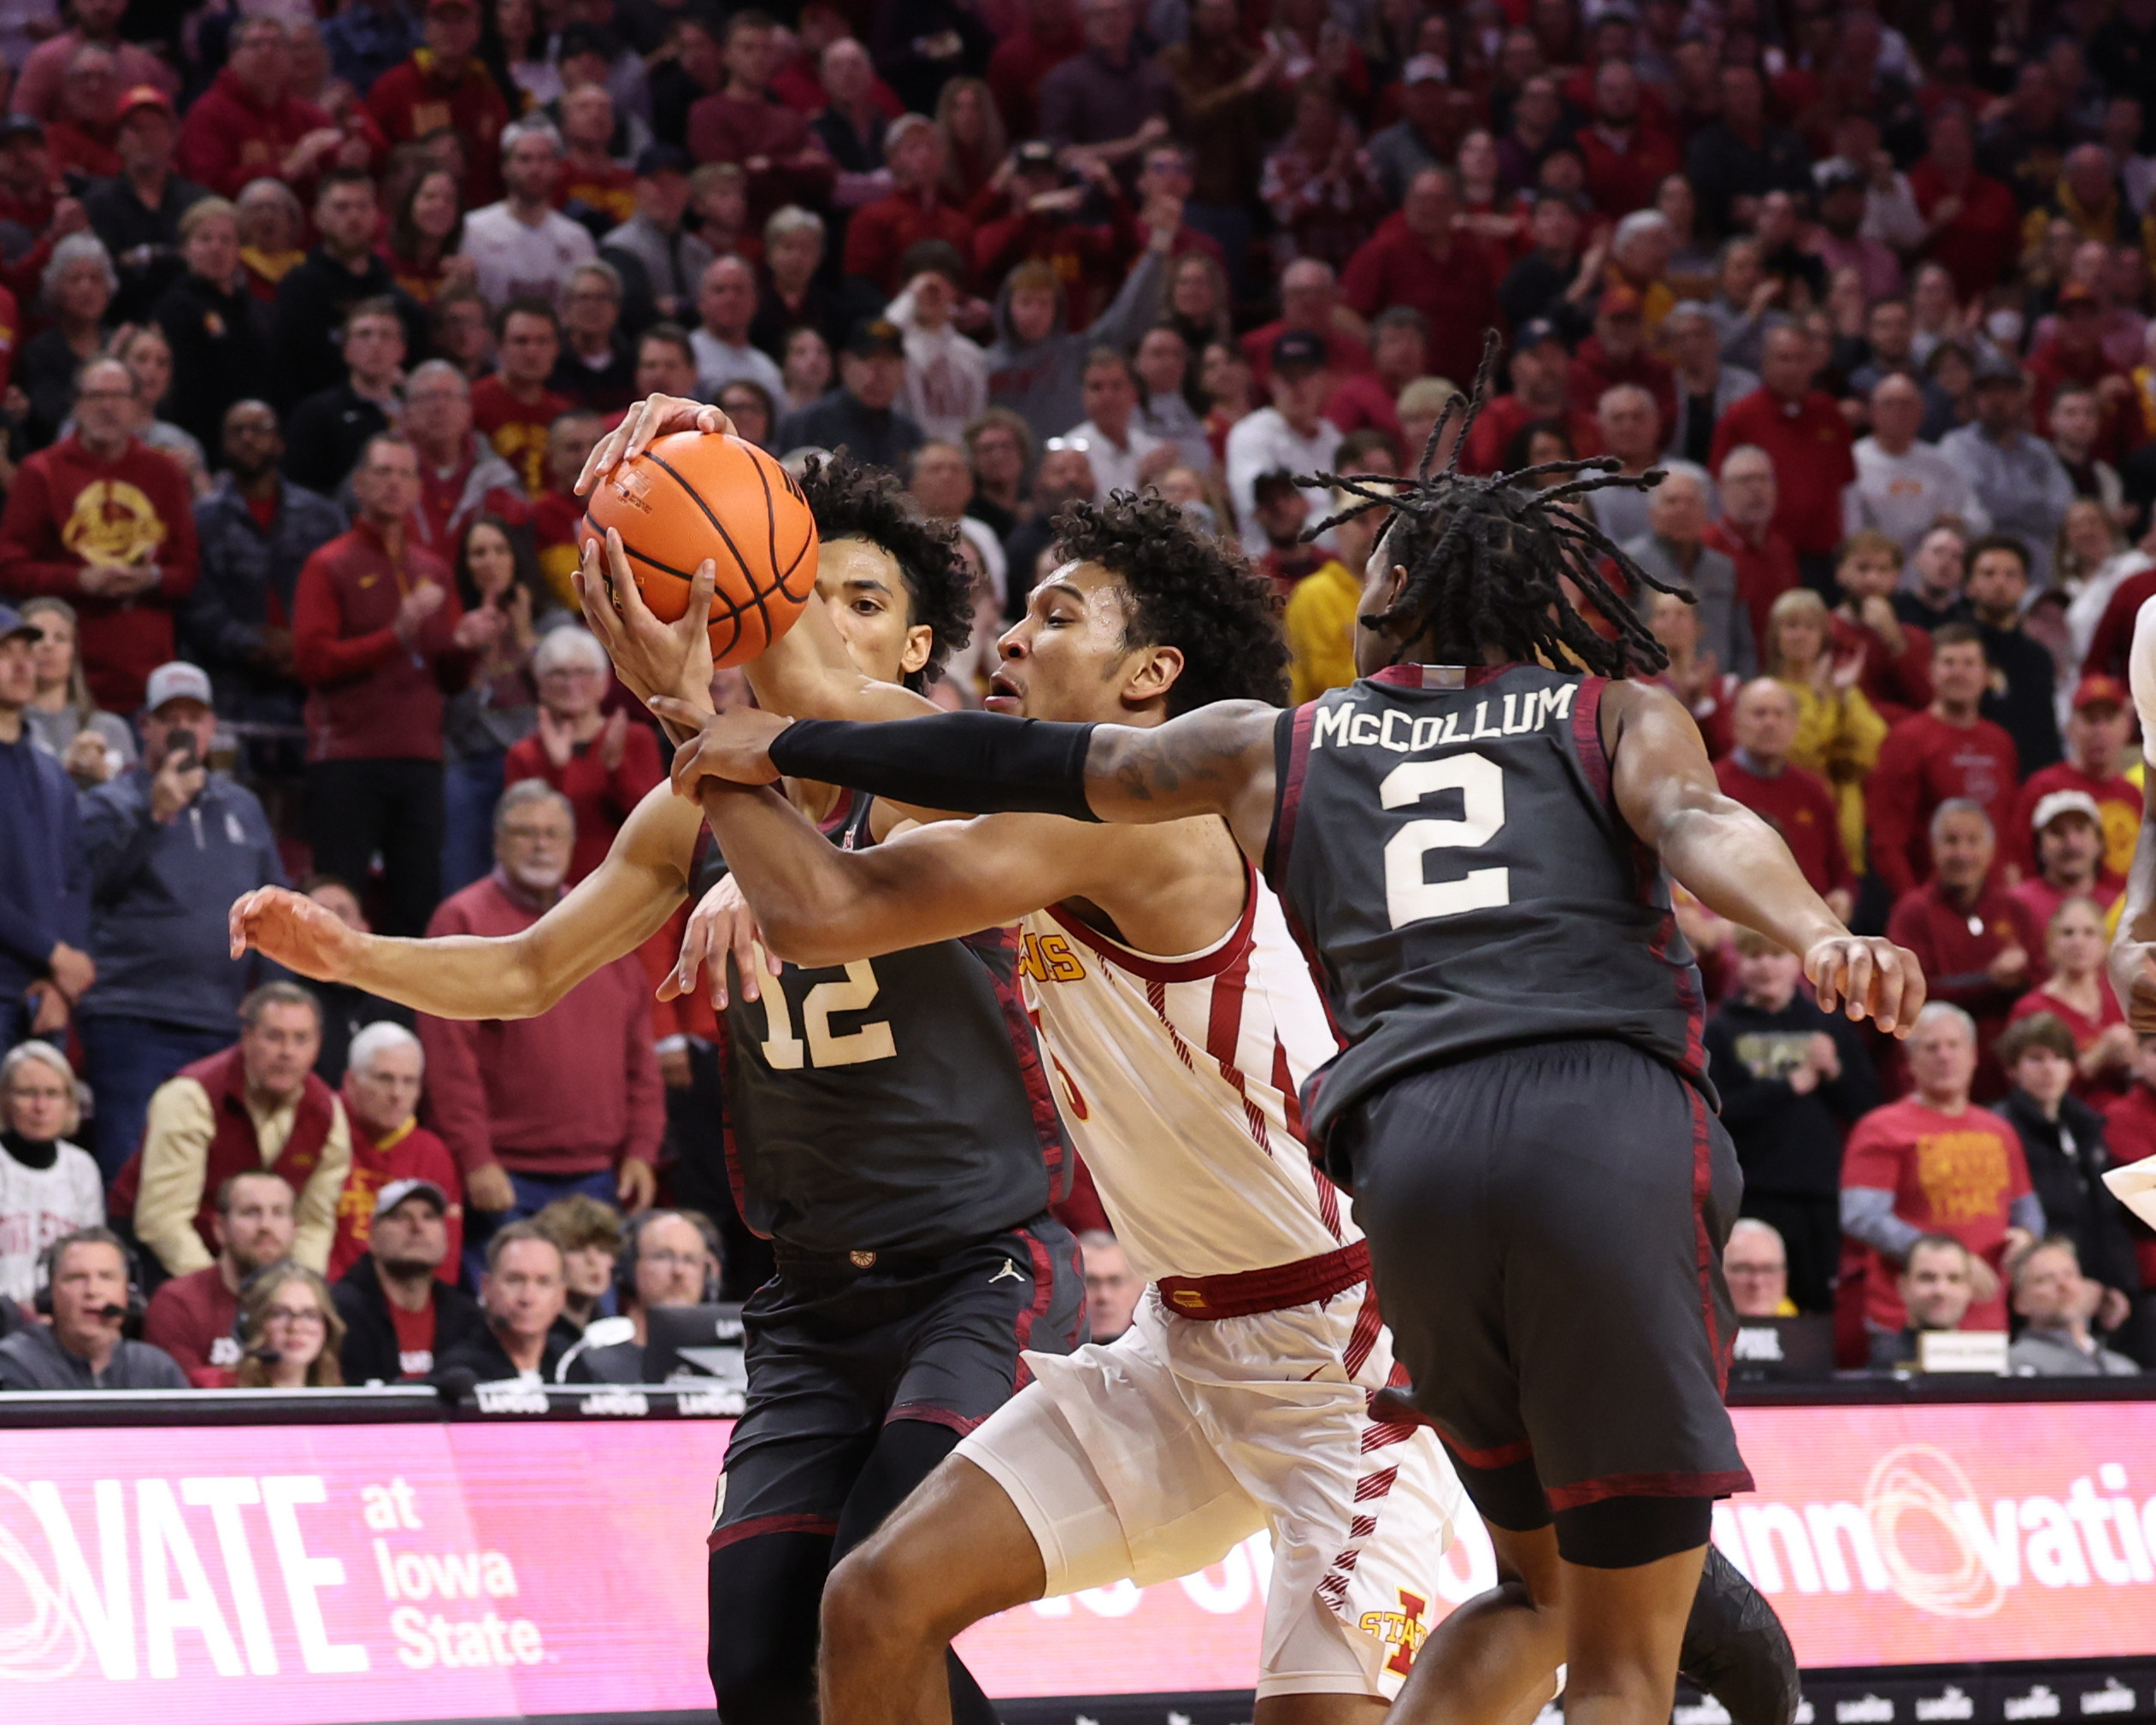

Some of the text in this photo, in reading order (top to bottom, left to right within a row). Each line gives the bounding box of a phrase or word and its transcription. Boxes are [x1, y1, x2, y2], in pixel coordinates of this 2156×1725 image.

[1379, 752, 1510, 931] 2
[751, 939, 898, 1069] 12
[362, 1478, 422, 1530] at
[373, 1538, 519, 1601] Iowa
[1359, 1610, 1429, 1654] STAT
